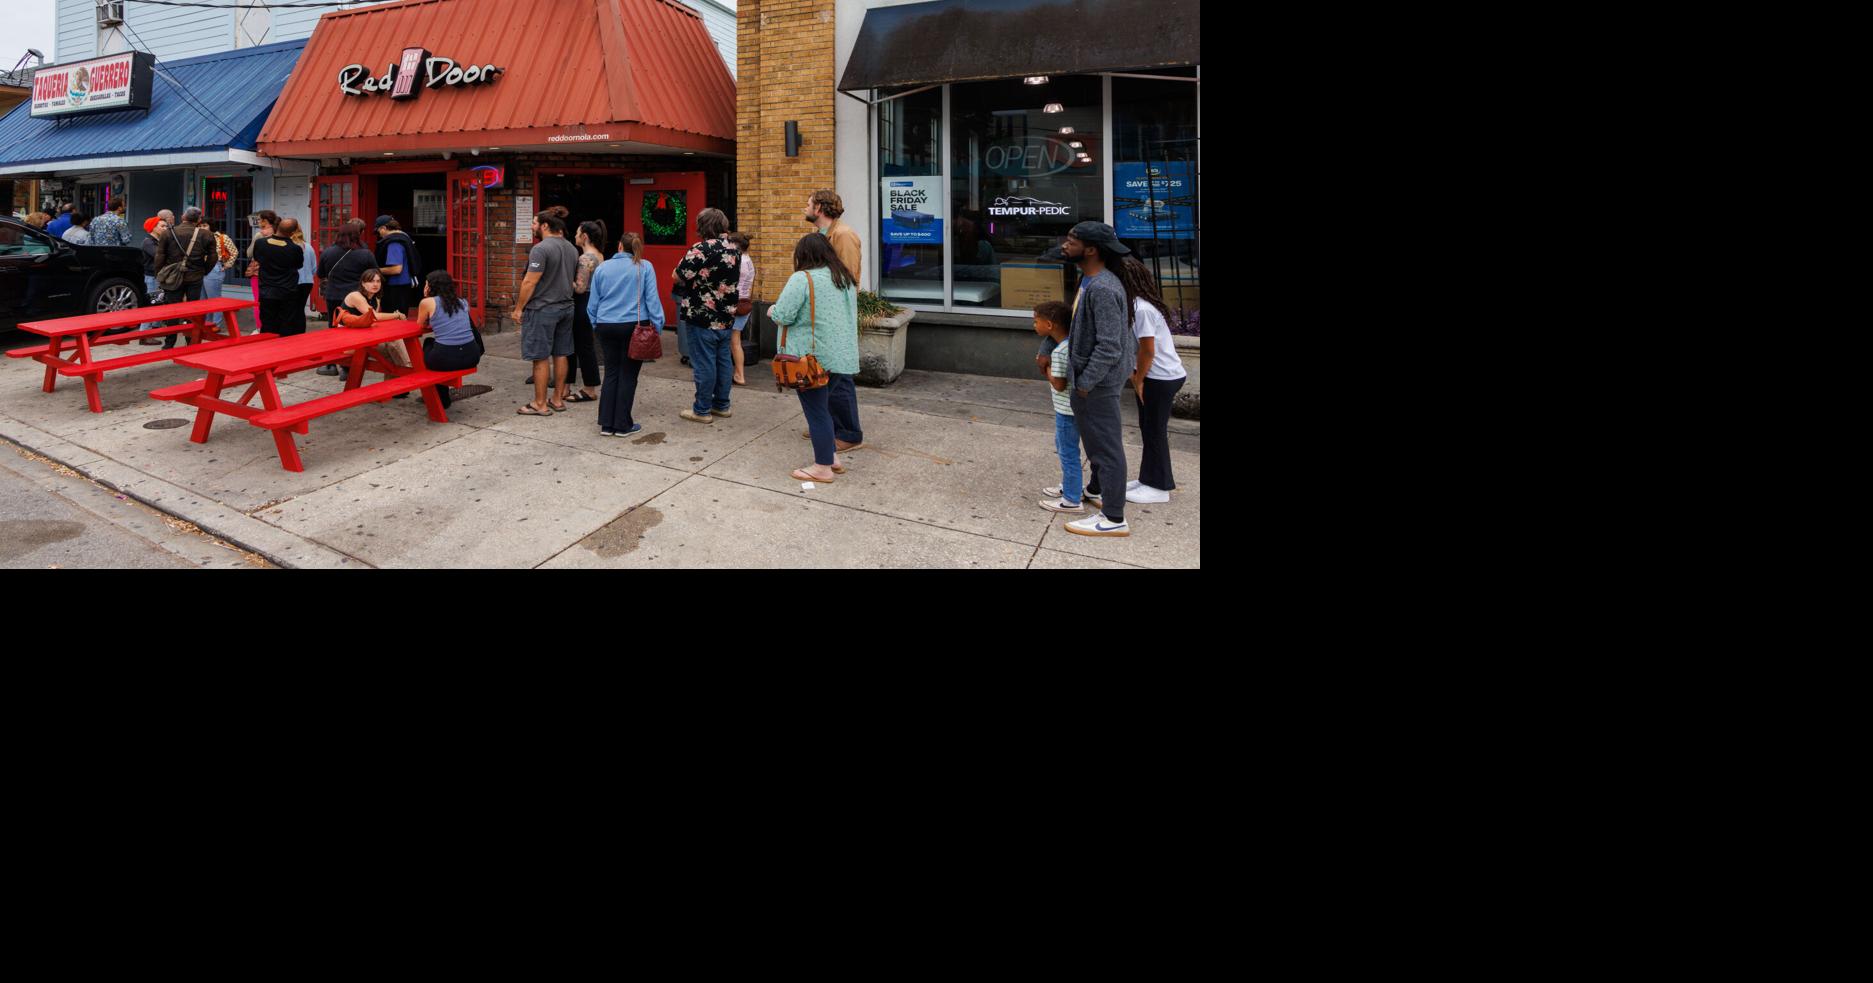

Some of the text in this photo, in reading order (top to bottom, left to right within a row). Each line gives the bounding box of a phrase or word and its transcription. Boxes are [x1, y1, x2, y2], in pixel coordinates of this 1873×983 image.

[33, 61, 129, 101] TAQUERIA GUERRERO
[338, 56, 502, 95] Red Door
[547, 133, 609, 143] reddoornola.com
[985, 145, 1059, 169] OPEN
[1126, 180, 1148, 188] SAVE
[988, 206, 1070, 216] TEMPUR-PEDIC
